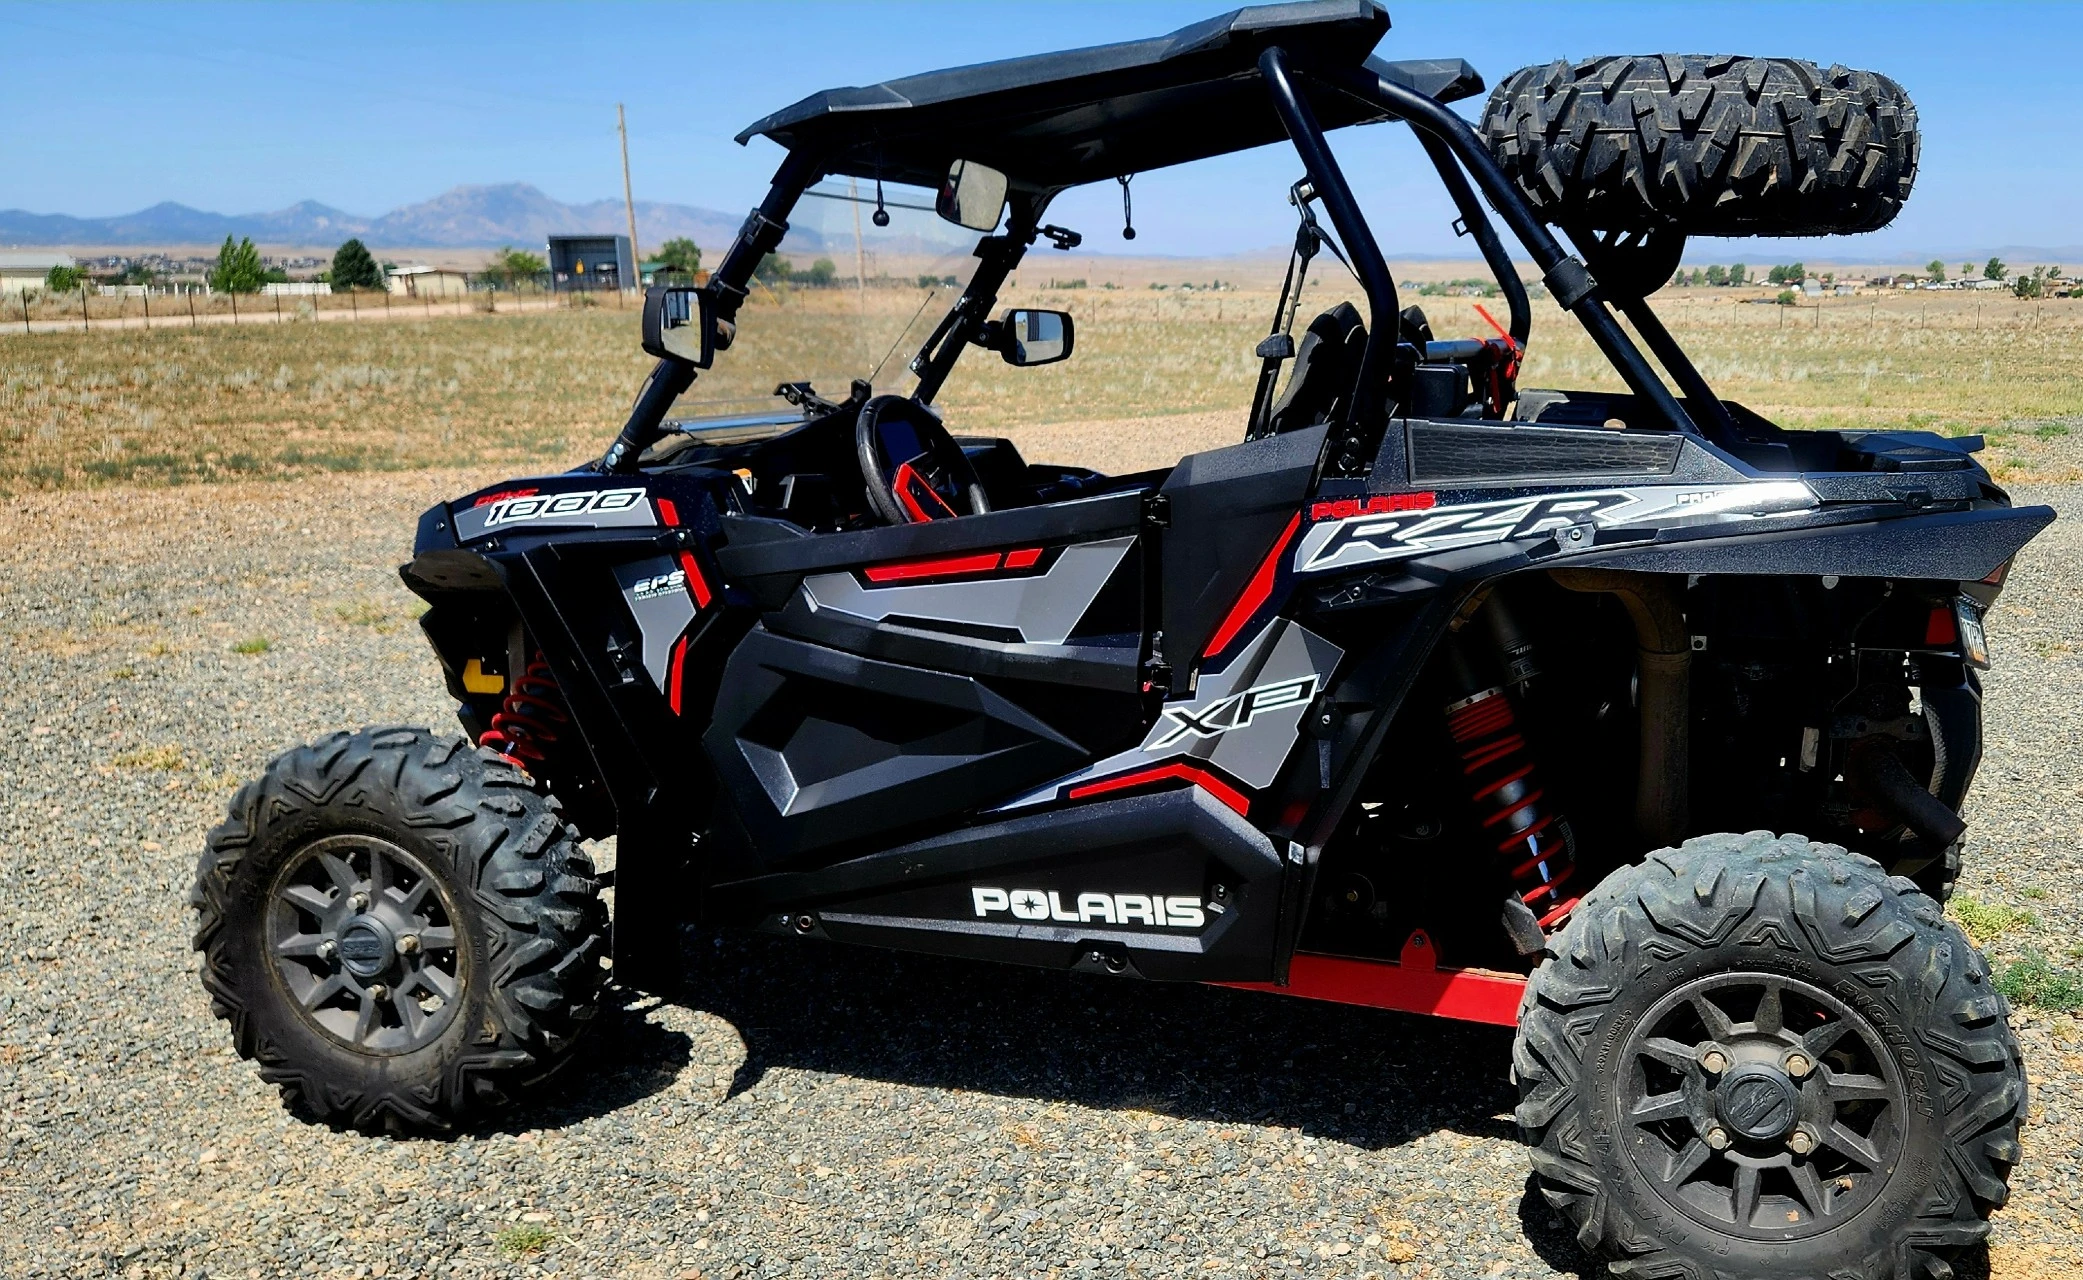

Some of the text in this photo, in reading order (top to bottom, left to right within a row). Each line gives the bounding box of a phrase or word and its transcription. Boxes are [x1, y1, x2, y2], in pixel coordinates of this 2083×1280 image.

[484, 488, 647, 527] 1000
[1312, 491, 1436, 521] POLARIS
[1300, 490, 1642, 571] RZR
[633, 569, 686, 593] EPS
[1143, 673, 1322, 752] XP
[971, 886, 1205, 928] POLARIS
[1833, 979, 1934, 1124] BIGHORN
